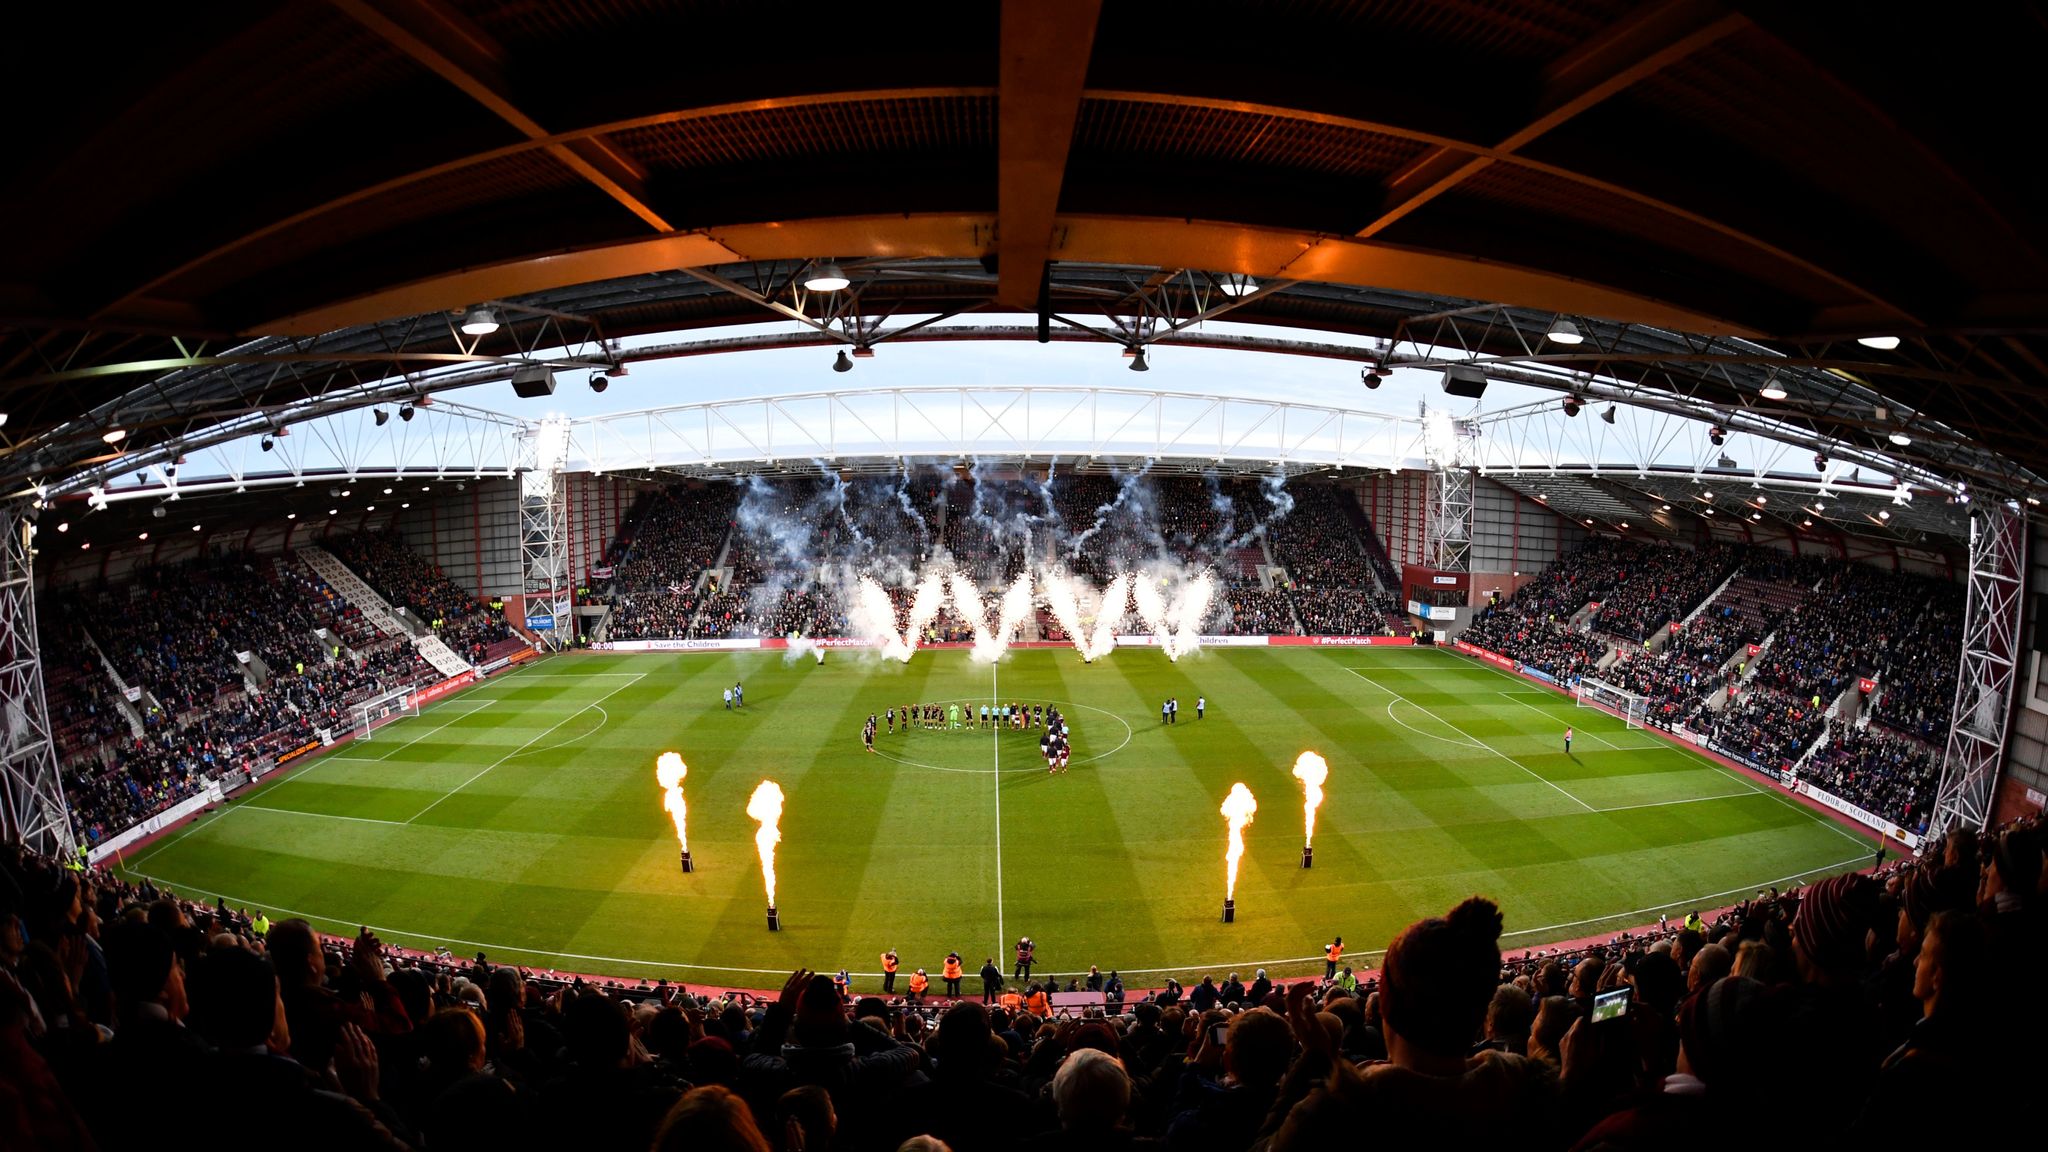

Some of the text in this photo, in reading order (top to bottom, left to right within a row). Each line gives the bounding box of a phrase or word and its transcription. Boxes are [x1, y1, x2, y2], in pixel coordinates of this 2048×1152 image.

[672, 640, 684, 648] the
[687, 639, 719, 648] Children
[1321, 637, 1371, 645] #PerfectMatch
[1719, 748, 1732, 757] where
[1732, 752, 1745, 763] home
[1744, 759, 1760, 771] buyers
[1760, 764, 1770, 775] look
[1770, 769, 1780, 780] first
[1817, 791, 1841, 807] FLOUR
[1849, 806, 1888, 829] SCOTLAND
